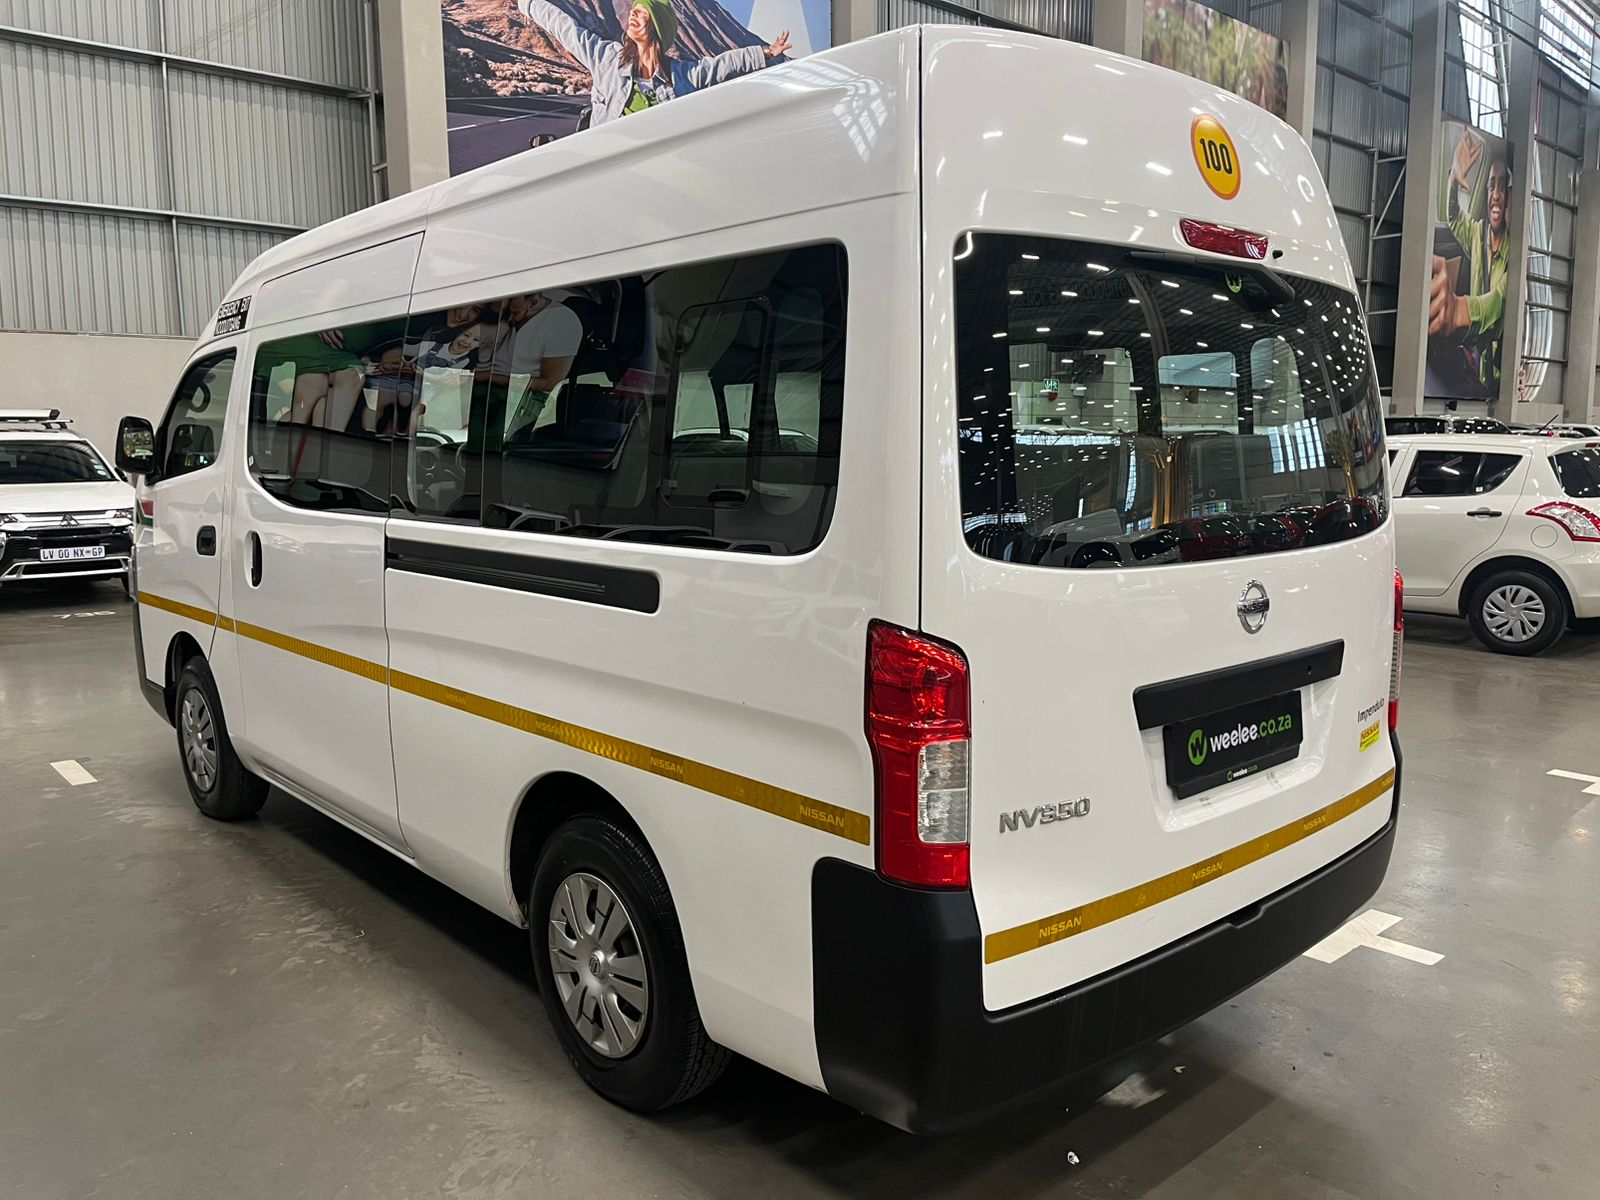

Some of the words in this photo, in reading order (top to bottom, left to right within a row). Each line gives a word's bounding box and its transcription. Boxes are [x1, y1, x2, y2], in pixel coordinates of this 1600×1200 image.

[1200, 138, 1232, 174] 100
[42, 550, 54, 560] LV
[58, 549, 70, 559] 00
[73, 548, 85, 558] NX
[92, 547, 103, 557] GP
[1210, 713, 1292, 753] weelee.co.za
[649, 756, 683, 775] NISSAN
[799, 804, 844, 828] NISSAN
[999, 796, 1091, 834] NV350
[1303, 815, 1327, 831] NISSAN
[1192, 861, 1223, 881] NISSAN
[1038, 915, 1082, 939] NISSAN
